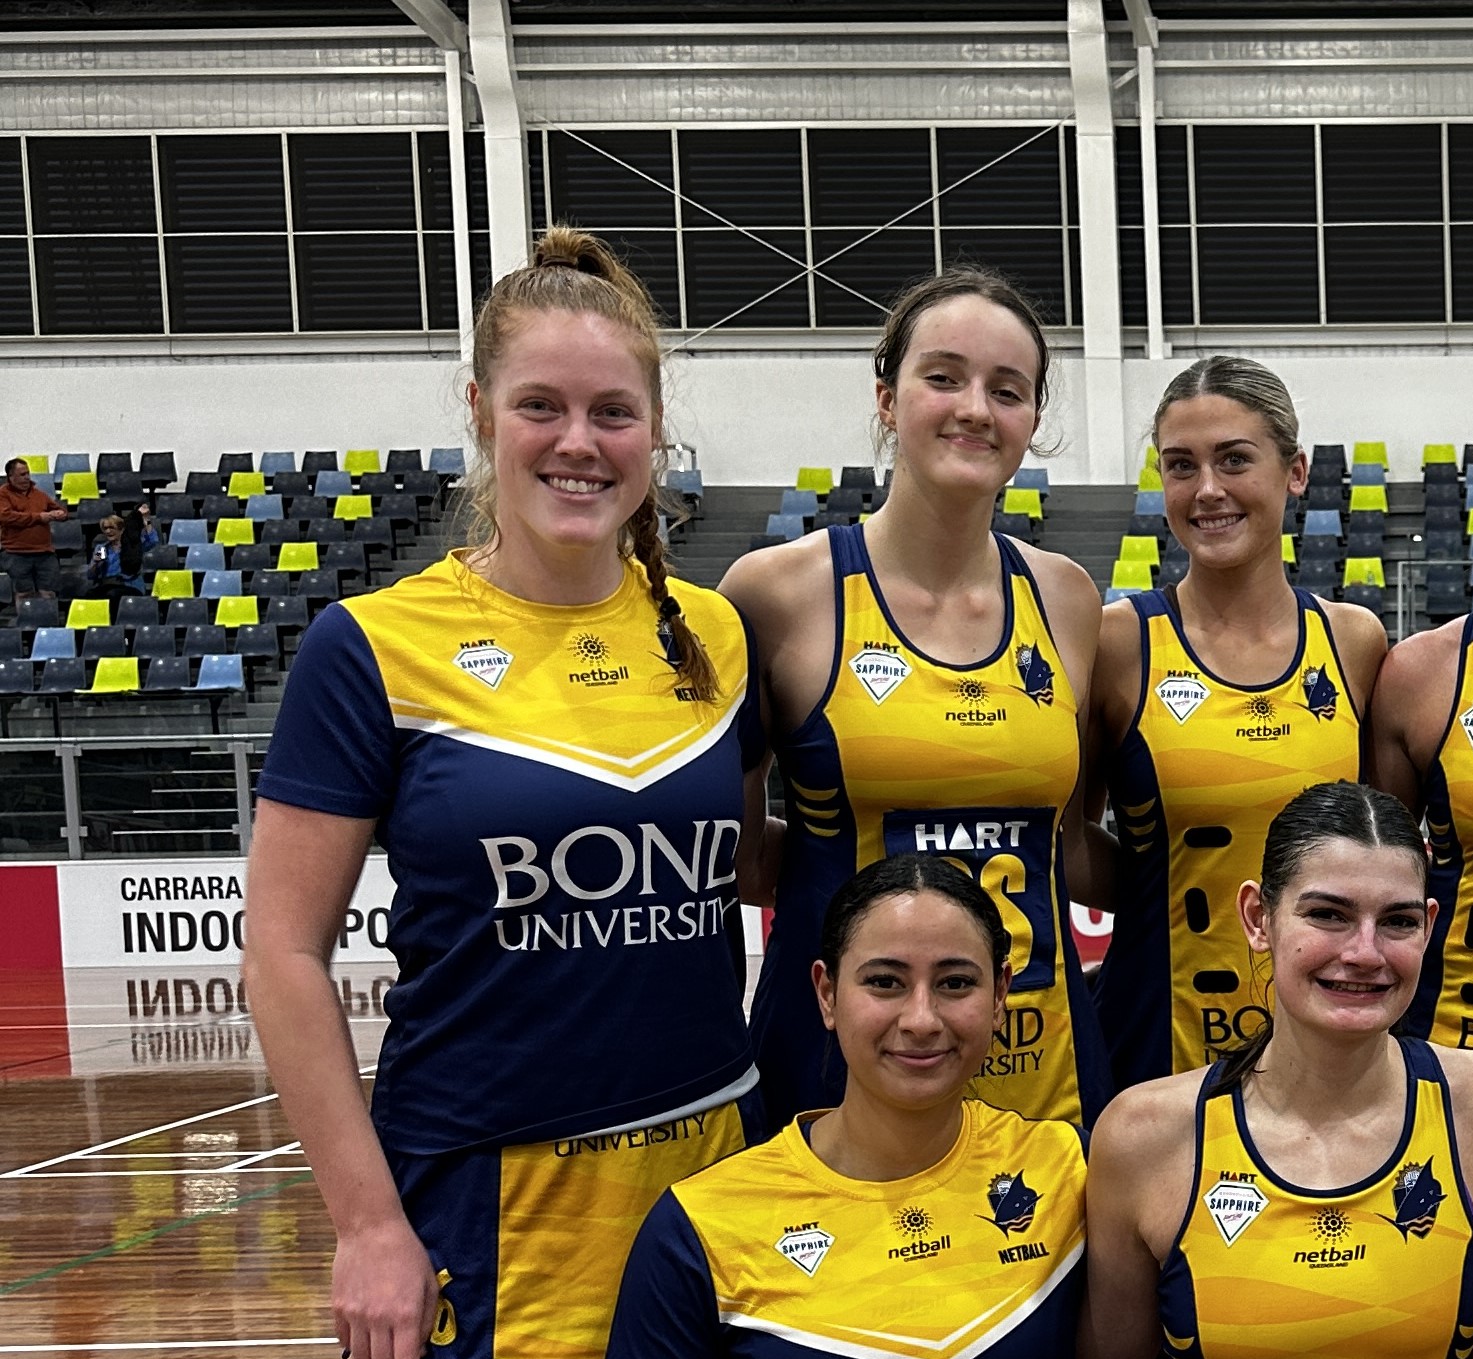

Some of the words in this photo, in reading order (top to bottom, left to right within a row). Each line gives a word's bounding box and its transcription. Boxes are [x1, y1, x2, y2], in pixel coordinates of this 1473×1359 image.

[459, 639, 496, 649] HART
[863, 640, 900, 654] HART
[460, 656, 509, 669] SAPPHIRE
[569, 666, 629, 684] netball
[855, 663, 906, 678] SAPPHIRE
[1167, 669, 1200, 680] HART
[1160, 688, 1205, 700] SAPPHIRE
[945, 708, 1007, 722] netball
[1236, 723, 1291, 738] netball
[914, 821, 1030, 851] HART
[478, 819, 742, 909] BOND
[120, 876, 244, 902] CARRARA
[493, 896, 738, 951] UNIVERSITY
[1219, 1171, 1258, 1183] HART
[1210, 1198, 1262, 1213] SAPPHIRE
[783, 1221, 820, 1234] HART
[781, 1239, 830, 1255] SAPPHIRE
[888, 1235, 951, 1260] netball
[997, 1242, 1050, 1265] NETBALL
[1293, 1244, 1366, 1263] netball
